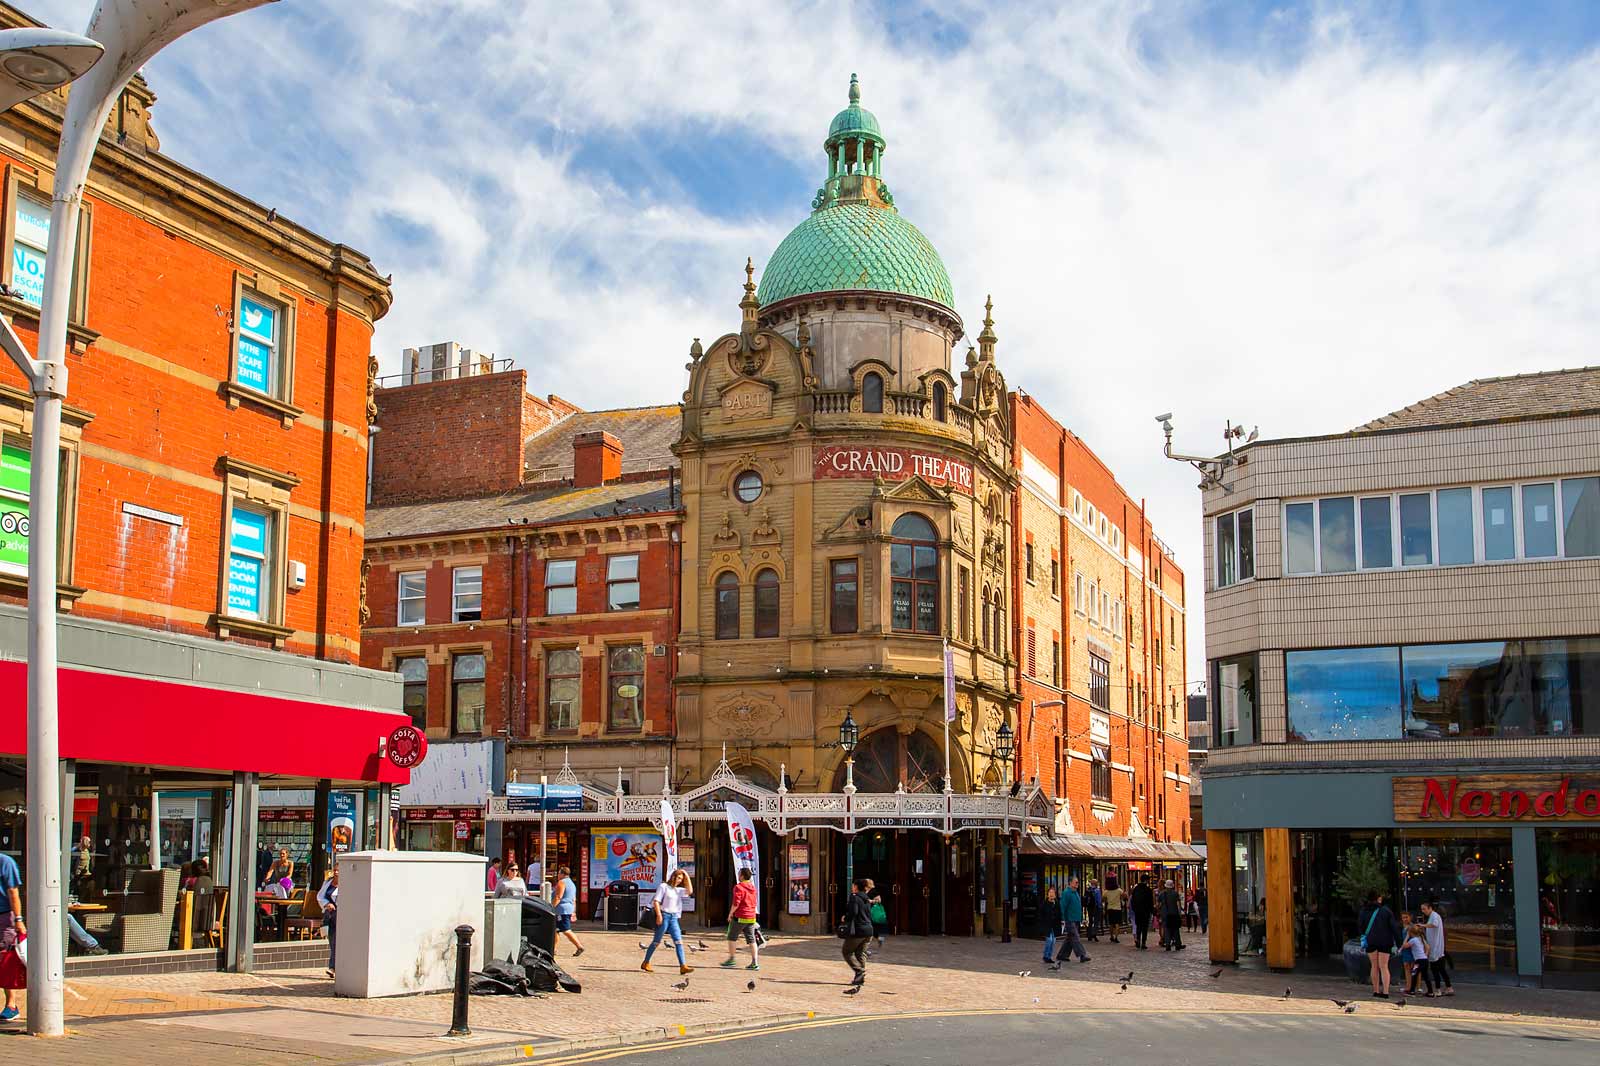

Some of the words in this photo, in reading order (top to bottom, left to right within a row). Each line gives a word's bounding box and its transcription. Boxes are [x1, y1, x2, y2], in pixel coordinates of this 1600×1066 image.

[18, 211, 50, 231] EUROP
[14, 274, 44, 291] ESCA
[238, 353, 263, 370] SCAPE
[238, 367, 263, 382] ENTRE
[818, 452, 834, 466] THE
[832, 451, 904, 473] GRAND
[910, 454, 972, 488] THEATRE
[230, 558, 258, 572] SCAPE
[229, 571, 256, 584] OOM
[229, 583, 257, 596] ENTRE
[393, 730, 415, 741] COSTA
[391, 750, 417, 764] COFFEE
[709, 802, 727, 810] STA
